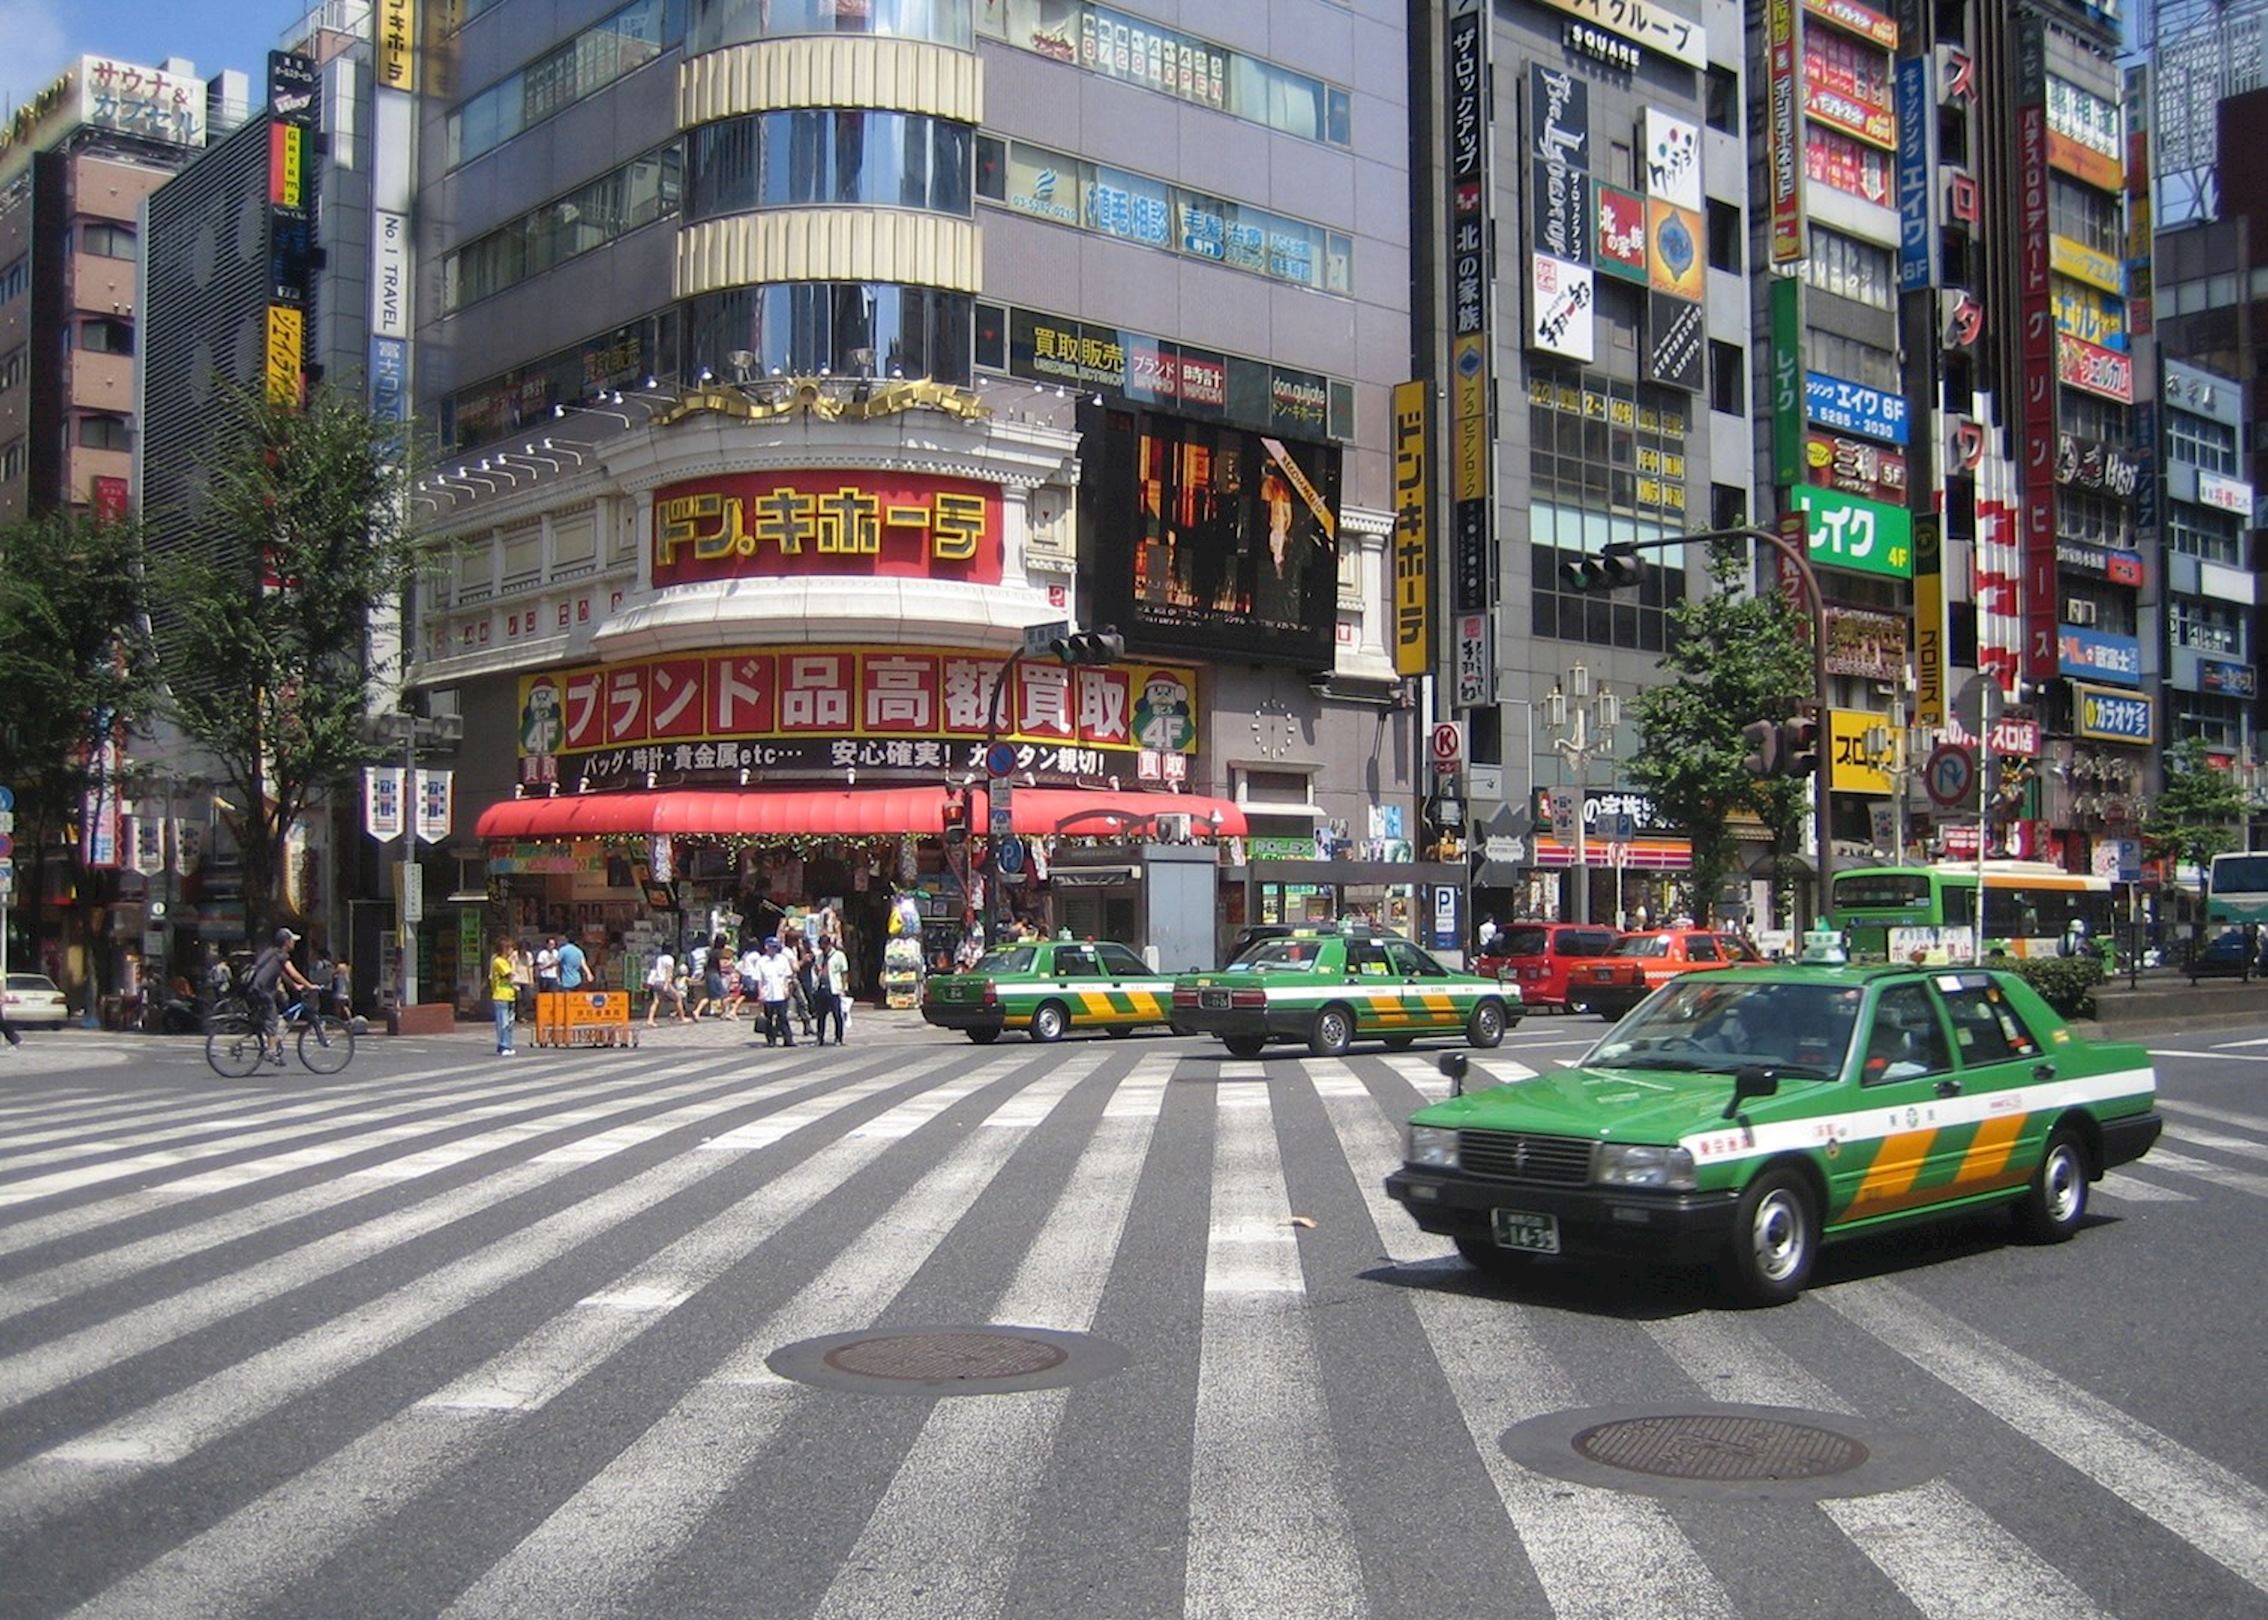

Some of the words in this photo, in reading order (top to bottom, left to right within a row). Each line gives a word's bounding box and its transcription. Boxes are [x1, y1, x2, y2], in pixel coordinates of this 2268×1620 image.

[1572, 24, 1640, 66] SQUARE
[1573, 0, 1692, 51] イグループ
[1902, 166, 1926, 246] エイワ
[2022, 108, 2045, 291] パチスロのデパート
[1599, 204, 1644, 258] 北の家族
[1455, 225, 1481, 333] 北の家族
[1903, 261, 1928, 282] 6F
[382, 264, 399, 331] TRAVEL
[1034, 325, 1124, 374] 買取販売
[1134, 355, 1175, 378] ブランド
[1183, 364, 1223, 388] 時計
[1777, 350, 1795, 413] レイク
[1836, 384, 1879, 415] エイワ
[1881, 399, 1905, 424] 6F
[1463, 388, 1480, 497] アラビアンロック
[1883, 464, 1903, 484] 5F
[2028, 310, 2050, 659] グリンピース
[1397, 412, 1423, 646] ドン・キホーテ
[1887, 547, 1908, 567] 4F
[1920, 629, 1939, 703] プロミス
[526, 720, 557, 751] 4F
[1142, 715, 1187, 749] 4F
[2095, 699, 2135, 732] カラオケ
[968, 742, 1105, 777] カタン親切!
[1140, 752, 1187, 778] 買取
[1255, 840, 1314, 855] ROLEX
[1438, 887, 1452, 915] P
